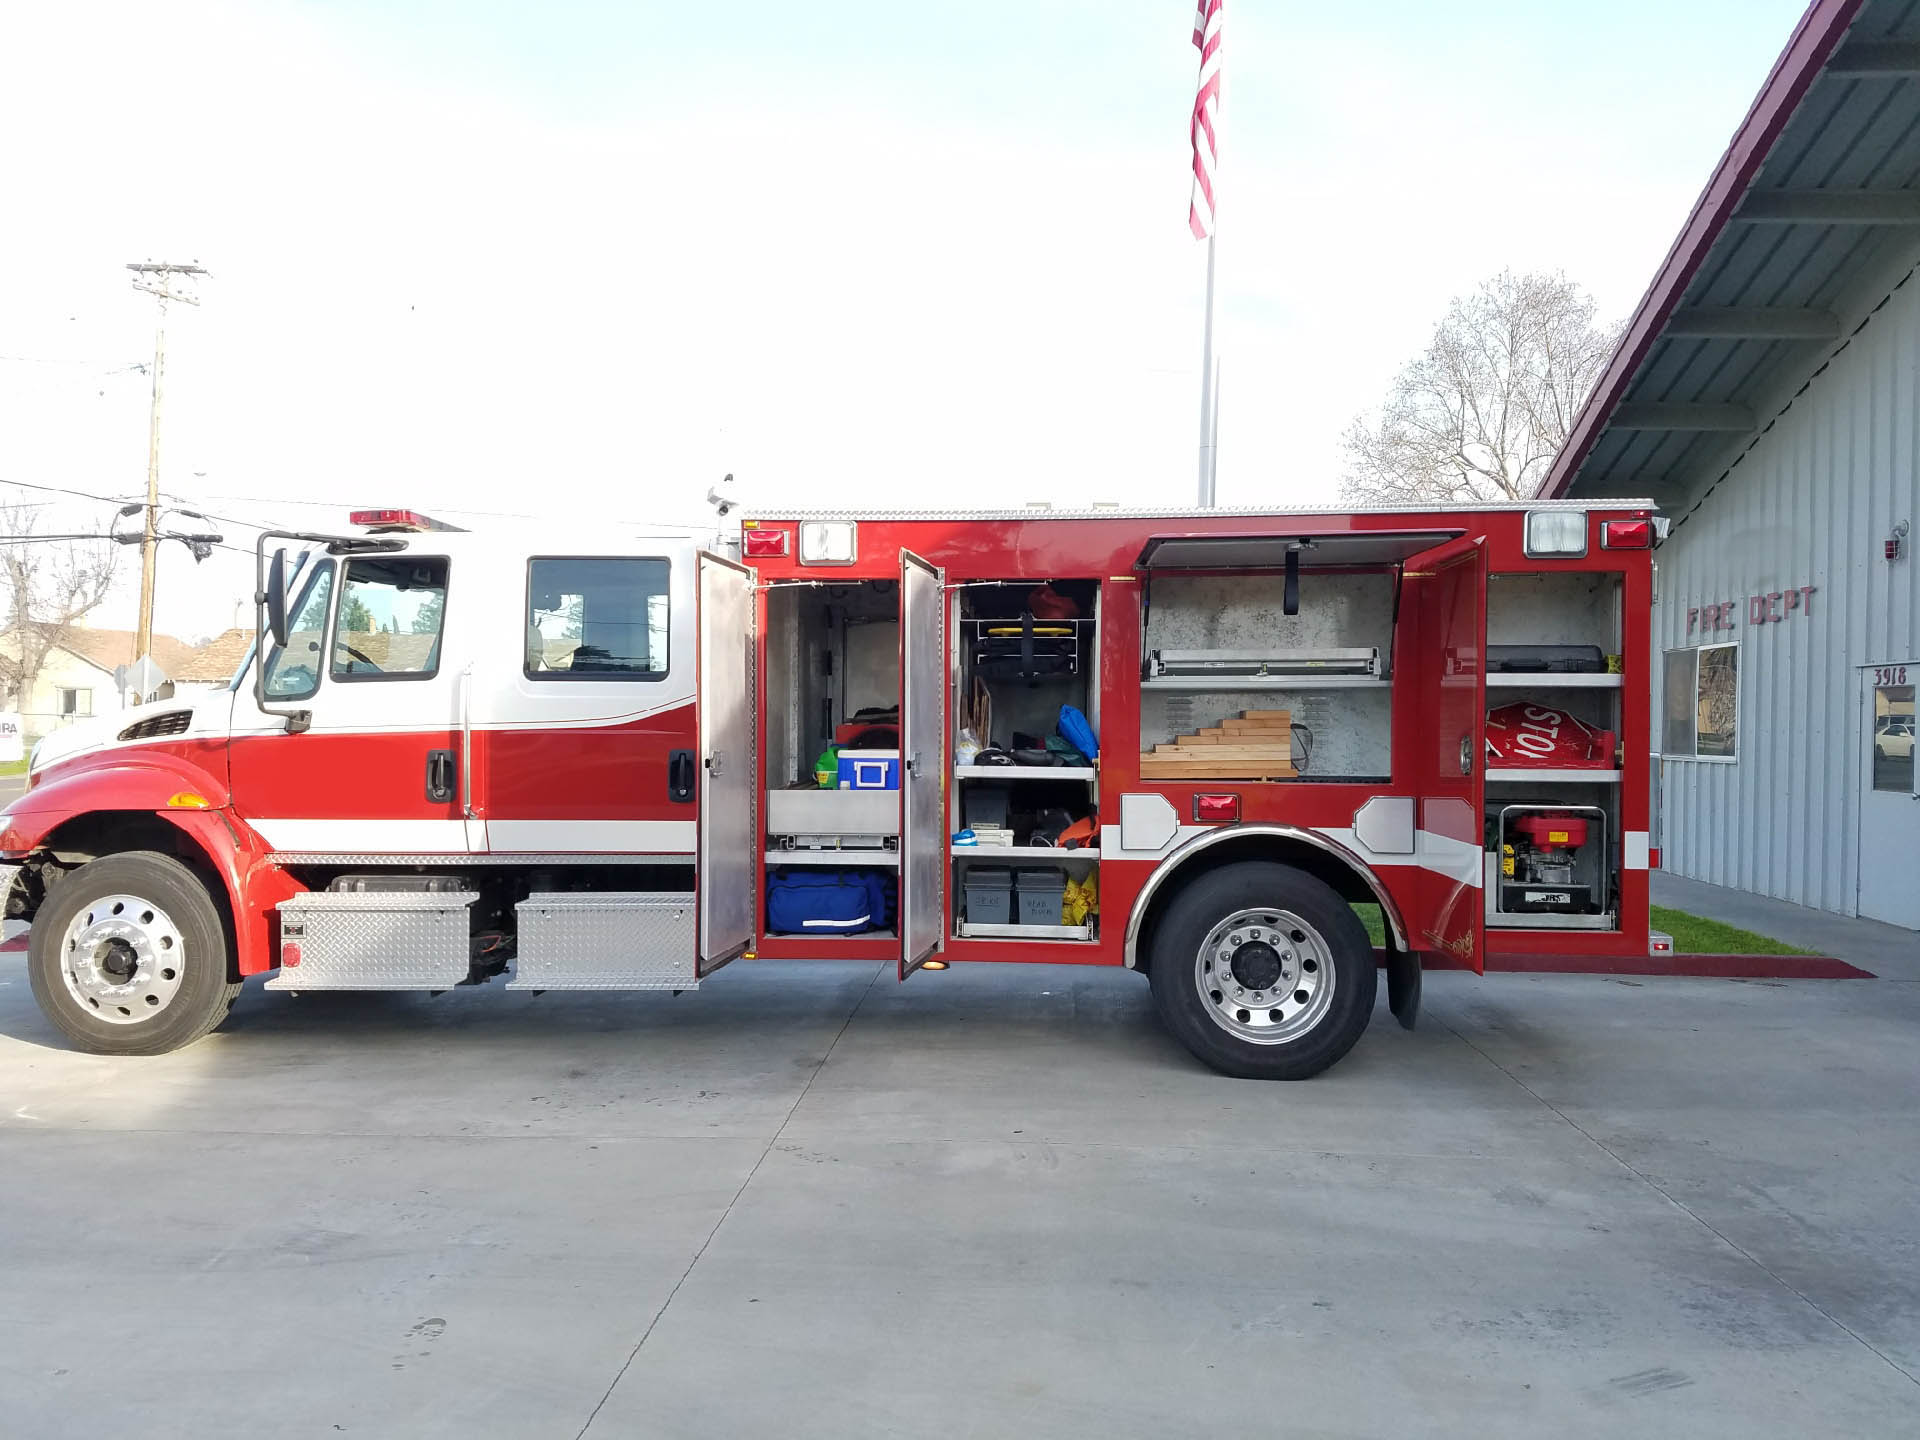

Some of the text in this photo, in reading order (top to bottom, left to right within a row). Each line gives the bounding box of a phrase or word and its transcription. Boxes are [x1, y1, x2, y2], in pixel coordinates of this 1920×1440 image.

[1687, 586, 1815, 636] FIRE DEPT
[1873, 667, 1906, 686] 3918
